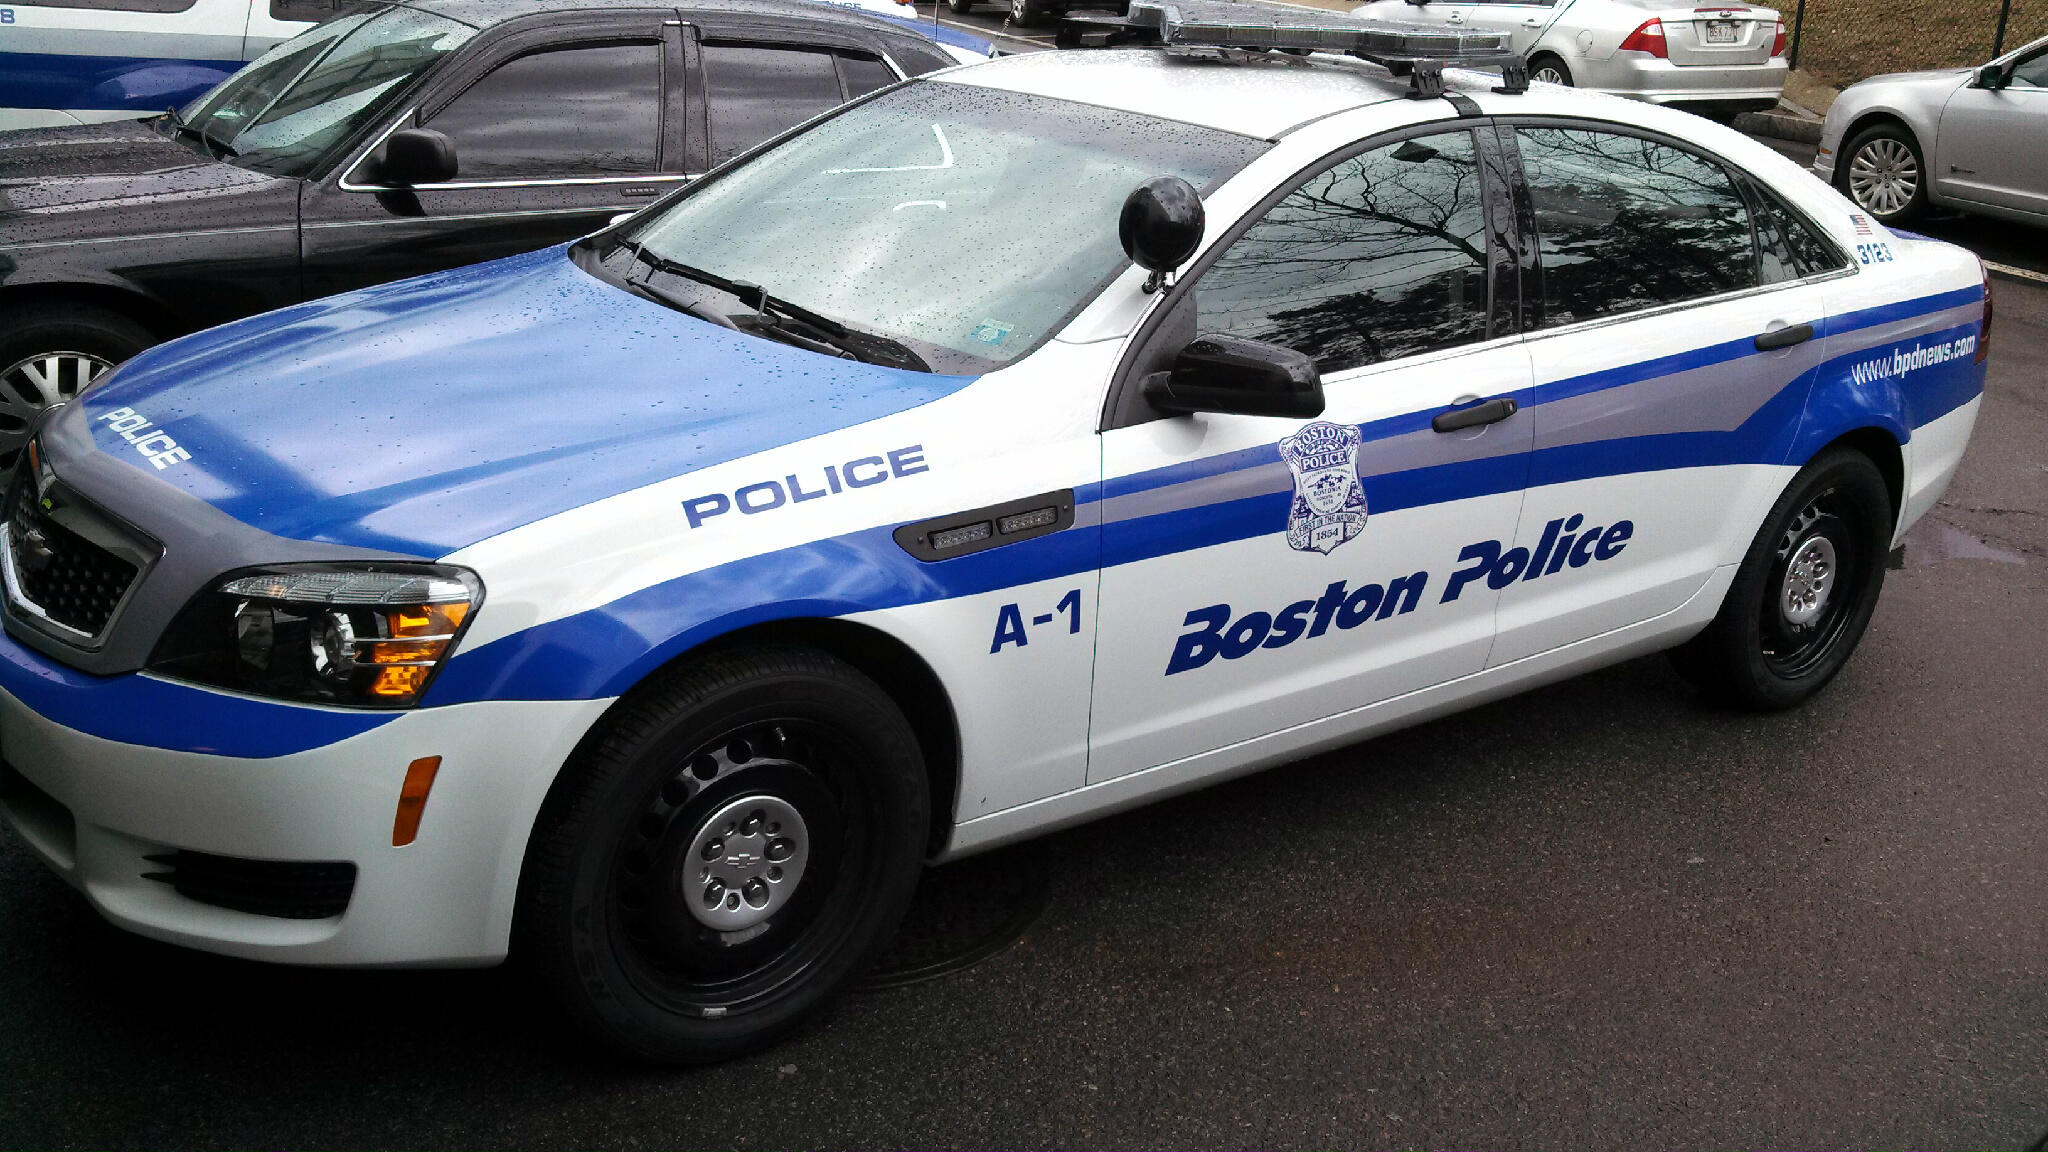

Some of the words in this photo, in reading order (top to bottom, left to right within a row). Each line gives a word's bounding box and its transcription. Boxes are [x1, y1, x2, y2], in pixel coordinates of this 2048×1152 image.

[1857, 242, 1893, 265] 3123
[1851, 334, 1976, 386] www.bpdnews.com
[96, 406, 193, 471] POLICE
[1297, 426, 1347, 450] BOSTON
[1302, 452, 1346, 470] POLICE
[682, 443, 930, 529] POLICE
[1316, 528, 1339, 541] 1854
[1325, 514, 1336, 523] THE
[1336, 513, 1357, 522] NATION
[1165, 570, 1429, 677] Boston
[1439, 512, 1635, 605] Police
[989, 588, 1083, 655] A-1
